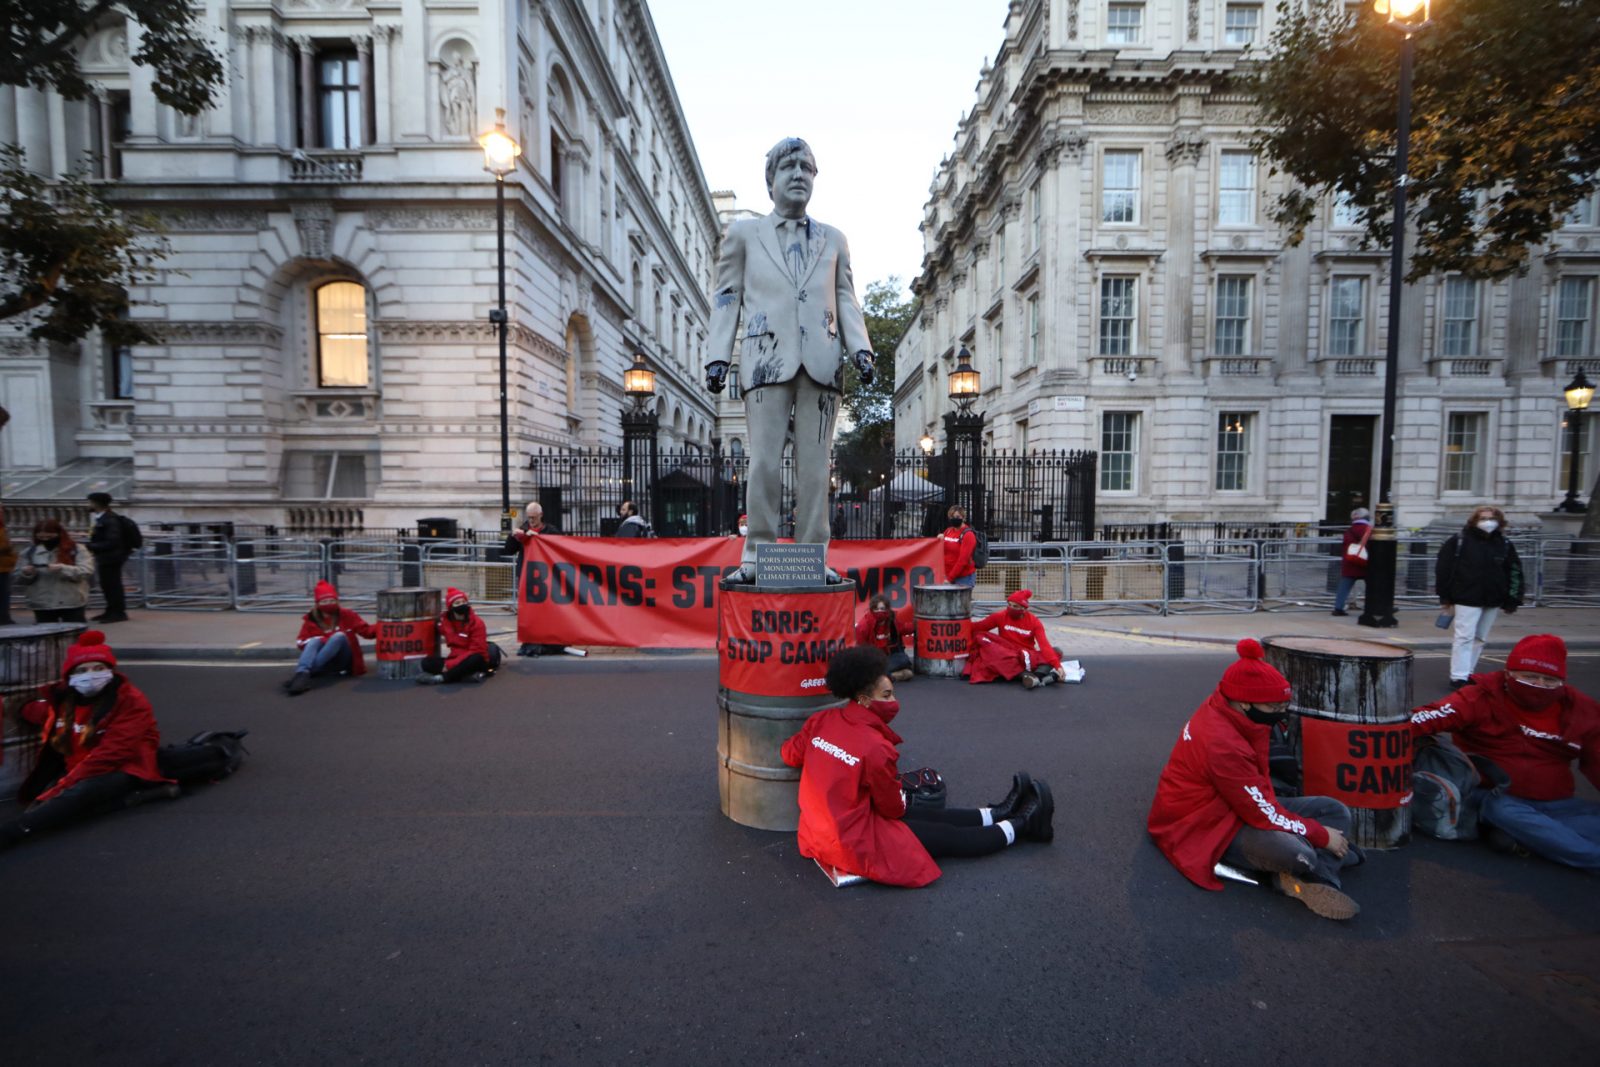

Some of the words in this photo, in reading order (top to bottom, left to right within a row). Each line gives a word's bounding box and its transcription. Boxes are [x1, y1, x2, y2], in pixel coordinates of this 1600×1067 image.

[525, 560, 656, 607] BORIS:
[672, 565, 741, 608] ST
[830, 566, 934, 609] MBO
[382, 624, 414, 638] STOP
[751, 609, 819, 634] BORIS:
[930, 623, 962, 637] STOP
[379, 639, 423, 653] CAMBO
[727, 636, 773, 663] STOP
[926, 638, 967, 653] CAMBO
[1347, 729, 1411, 760] STOP
